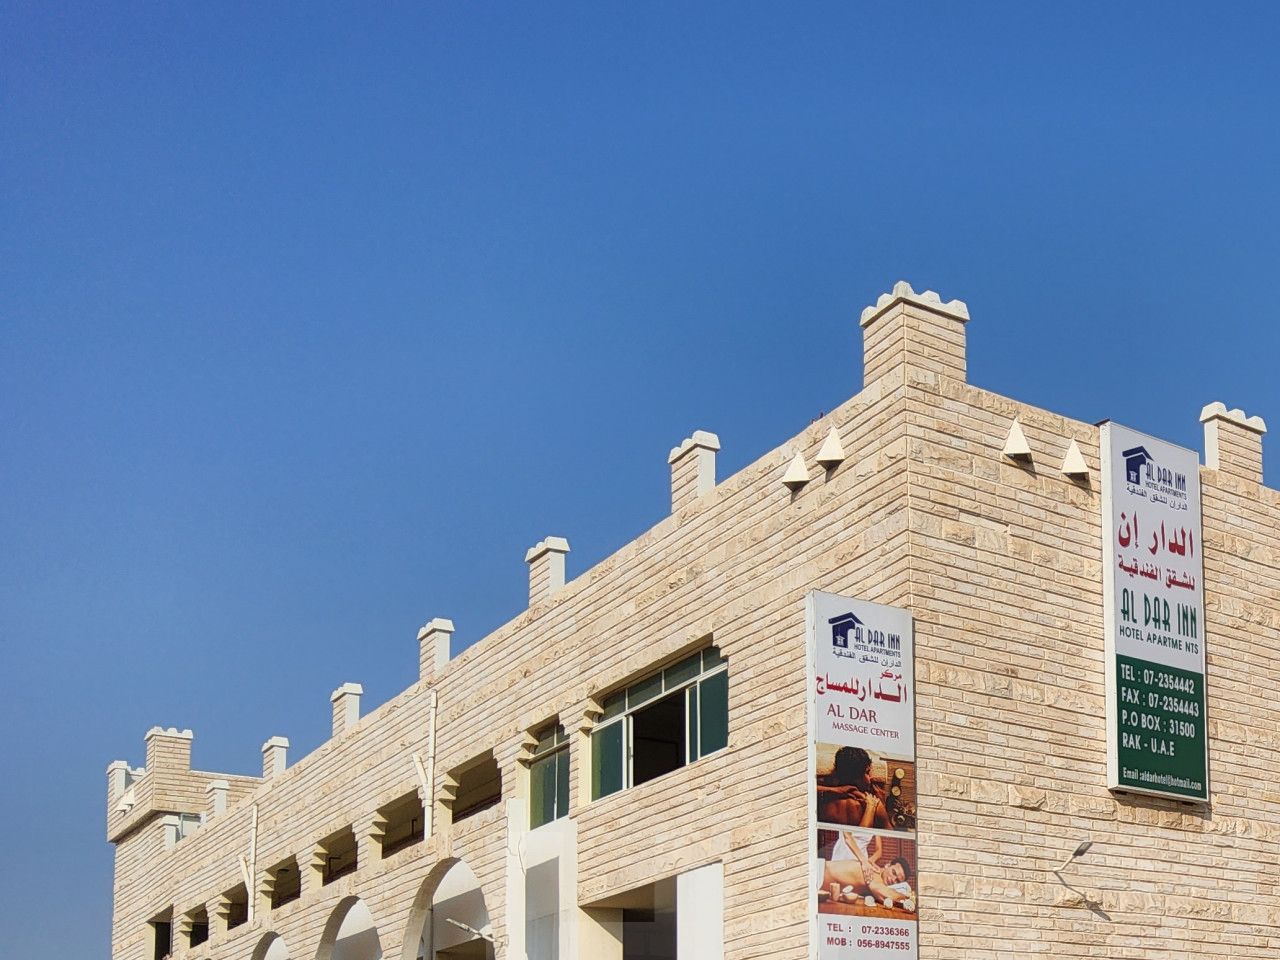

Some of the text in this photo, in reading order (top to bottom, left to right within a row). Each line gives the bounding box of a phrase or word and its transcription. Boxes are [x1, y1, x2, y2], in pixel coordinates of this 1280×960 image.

[1146, 462, 1187, 492] AL DAR INN
[1145, 480, 1187, 501] HOTEL APARTMENTS
[1148, 519, 1194, 559] الدار
[1117, 553, 1196, 591] للشقق الفندقية
[1120, 587, 1198, 639] AL DAR INN
[855, 626, 901, 651] AL DAR INN
[1119, 625, 1144, 641] HOTEL
[832, 646, 856, 659] الفندقية
[854, 643, 902, 658] HOTEL APARTMENTS
[1120, 663, 1136, 681] TEL
[1143, 668, 1195, 695] 07-2354442
[826, 702, 878, 724] AL DAR
[1121, 686, 1140, 705] FAX
[1148, 692, 1200, 718] 07-2354443
[831, 721, 900, 739] MASSAGE CENTER
[1122, 709, 1139, 727] P.O
[1141, 713, 1161, 732] BOX
[1169, 718, 1196, 739] 31500
[1122, 732, 1141, 750] RAK
[1150, 737, 1175, 757] U.A.E
[1122, 766, 1139, 780] Email
[826, 923, 844, 932] TEL
[861, 925, 910, 937] 07-2336366
[826, 937, 847, 946] MOB
[857, 939, 911, 951] 056-8947555
